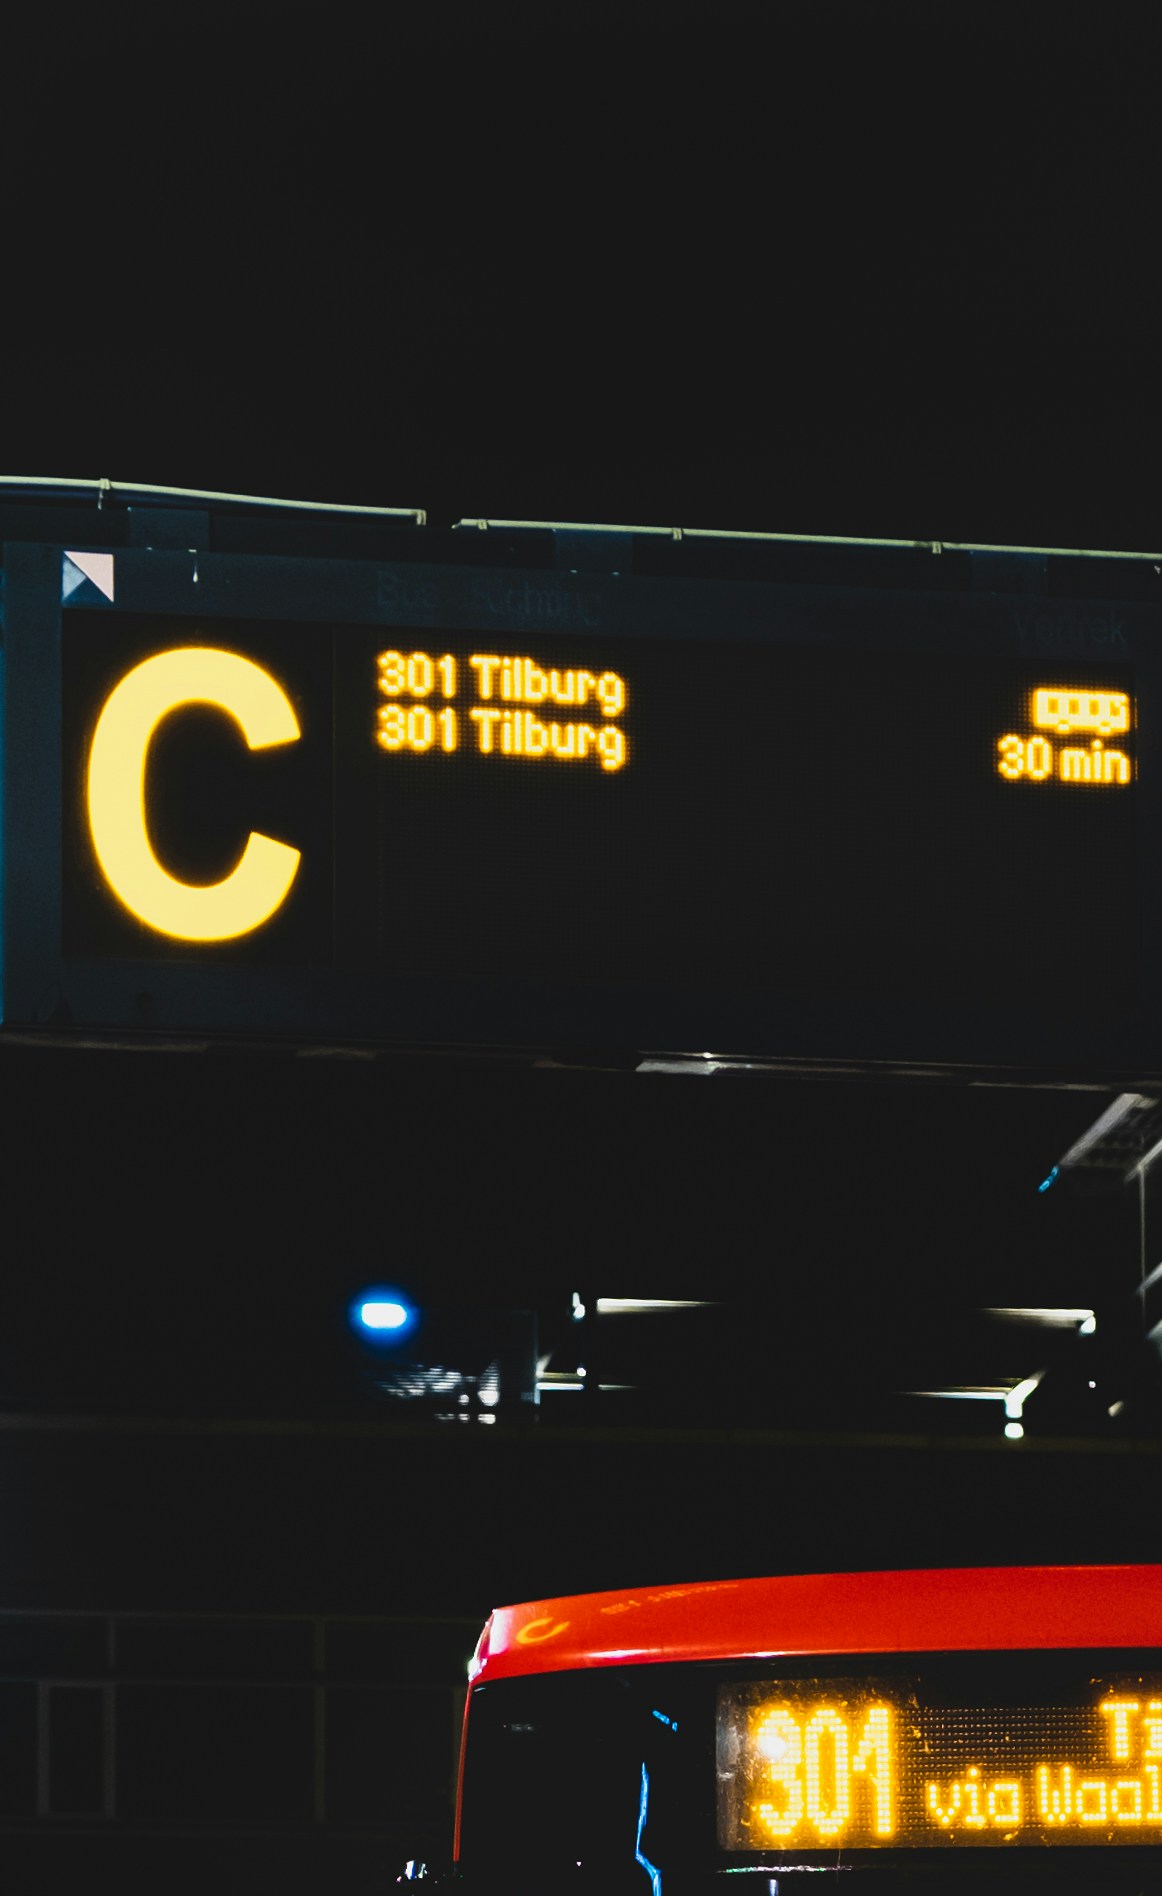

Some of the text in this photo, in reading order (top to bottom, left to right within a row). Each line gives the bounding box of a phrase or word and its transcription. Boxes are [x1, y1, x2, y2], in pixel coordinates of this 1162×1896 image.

[378, 650, 626, 717] 301 Tilburg
[378, 703, 626, 770] 301 Tilburg
[998, 734, 1131, 784] 30 min
[87, 646, 302, 942] C
[756, 1702, 896, 1838] 301
[925, 1765, 1021, 1826] via
